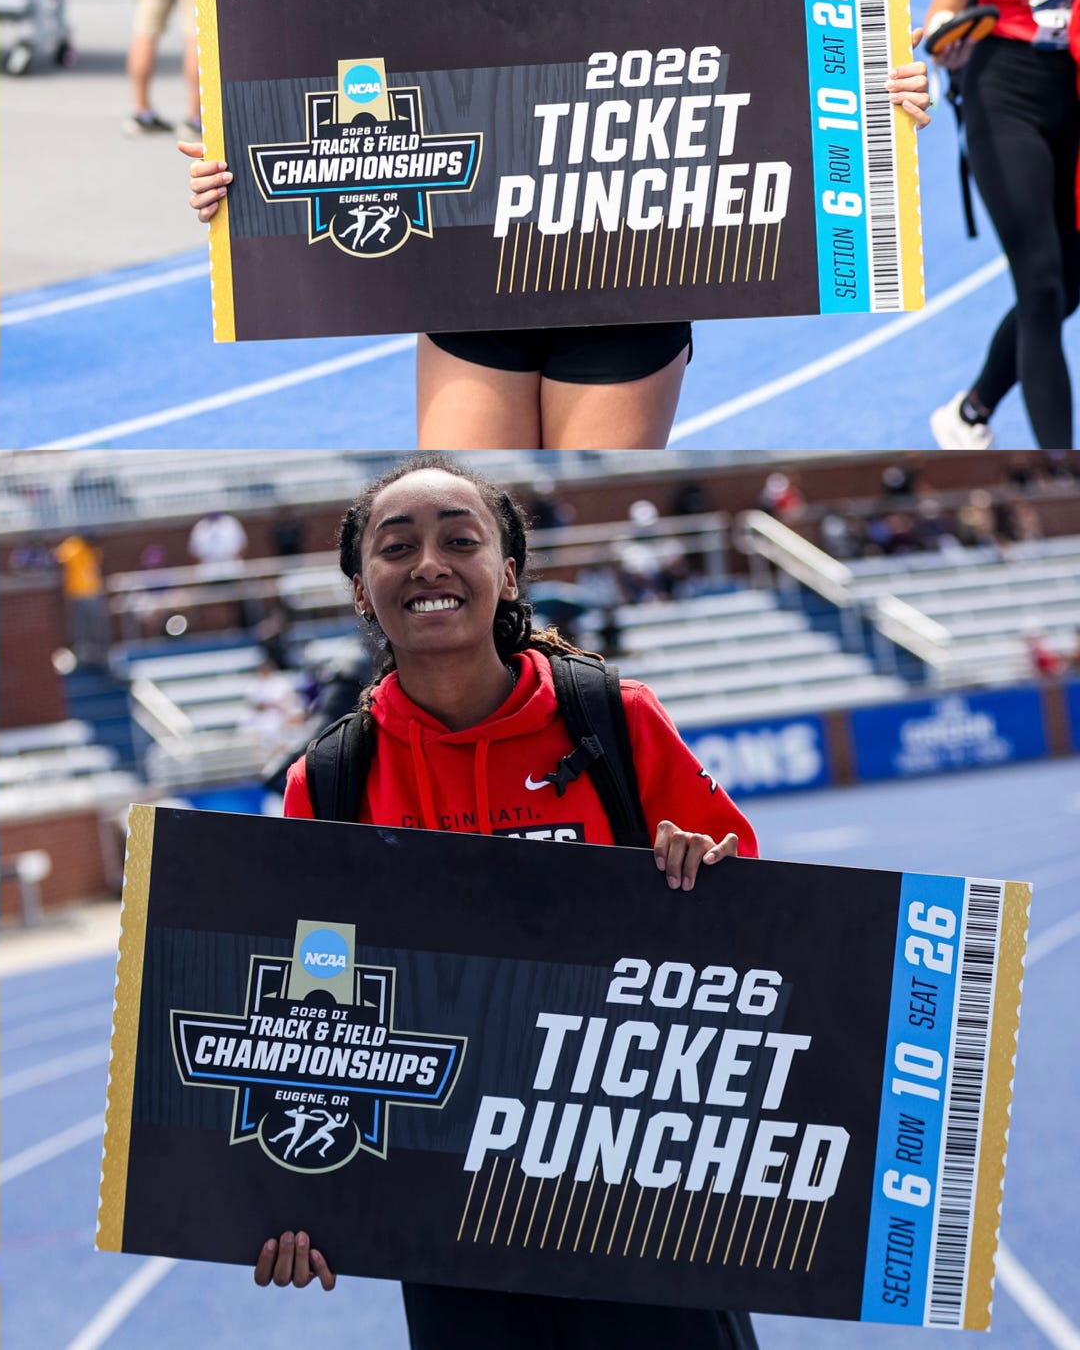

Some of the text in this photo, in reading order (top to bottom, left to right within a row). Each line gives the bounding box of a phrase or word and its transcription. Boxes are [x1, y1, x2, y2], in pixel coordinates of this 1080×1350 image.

[585, 45, 721, 90] 2026
[822, 34, 846, 75] SEAT
[347, 82, 382, 95] NCAA
[817, 86, 859, 131] 10
[311, 134, 420, 156] TRACK & FIELD
[342, 127, 371, 136] 2026
[534, 92, 751, 166] TICKET
[272, 151, 463, 185] CHAMPIONSHIPS
[829, 143, 851, 183] ROW
[339, 192, 398, 204] EUGENE, OR
[493, 161, 792, 238] PUNCHED
[822, 189, 863, 218] 6
[836, 227, 857, 300] SECTION
[304, 952, 347, 968] NCAA
[605, 957, 783, 1016] 2026
[249, 1015, 387, 1047] TRACK & FIELD
[290, 1006, 326, 1019] 2026
[194, 1035, 439, 1086] CHAMPIONSHIPS
[532, 1012, 812, 1111] TICKET
[274, 1090, 350, 1107] EUGENE, OR
[882, 901, 957, 1308] SECTION 6 ROW 10 SEAT 26
[463, 1095, 851, 1203] PUNCHED
